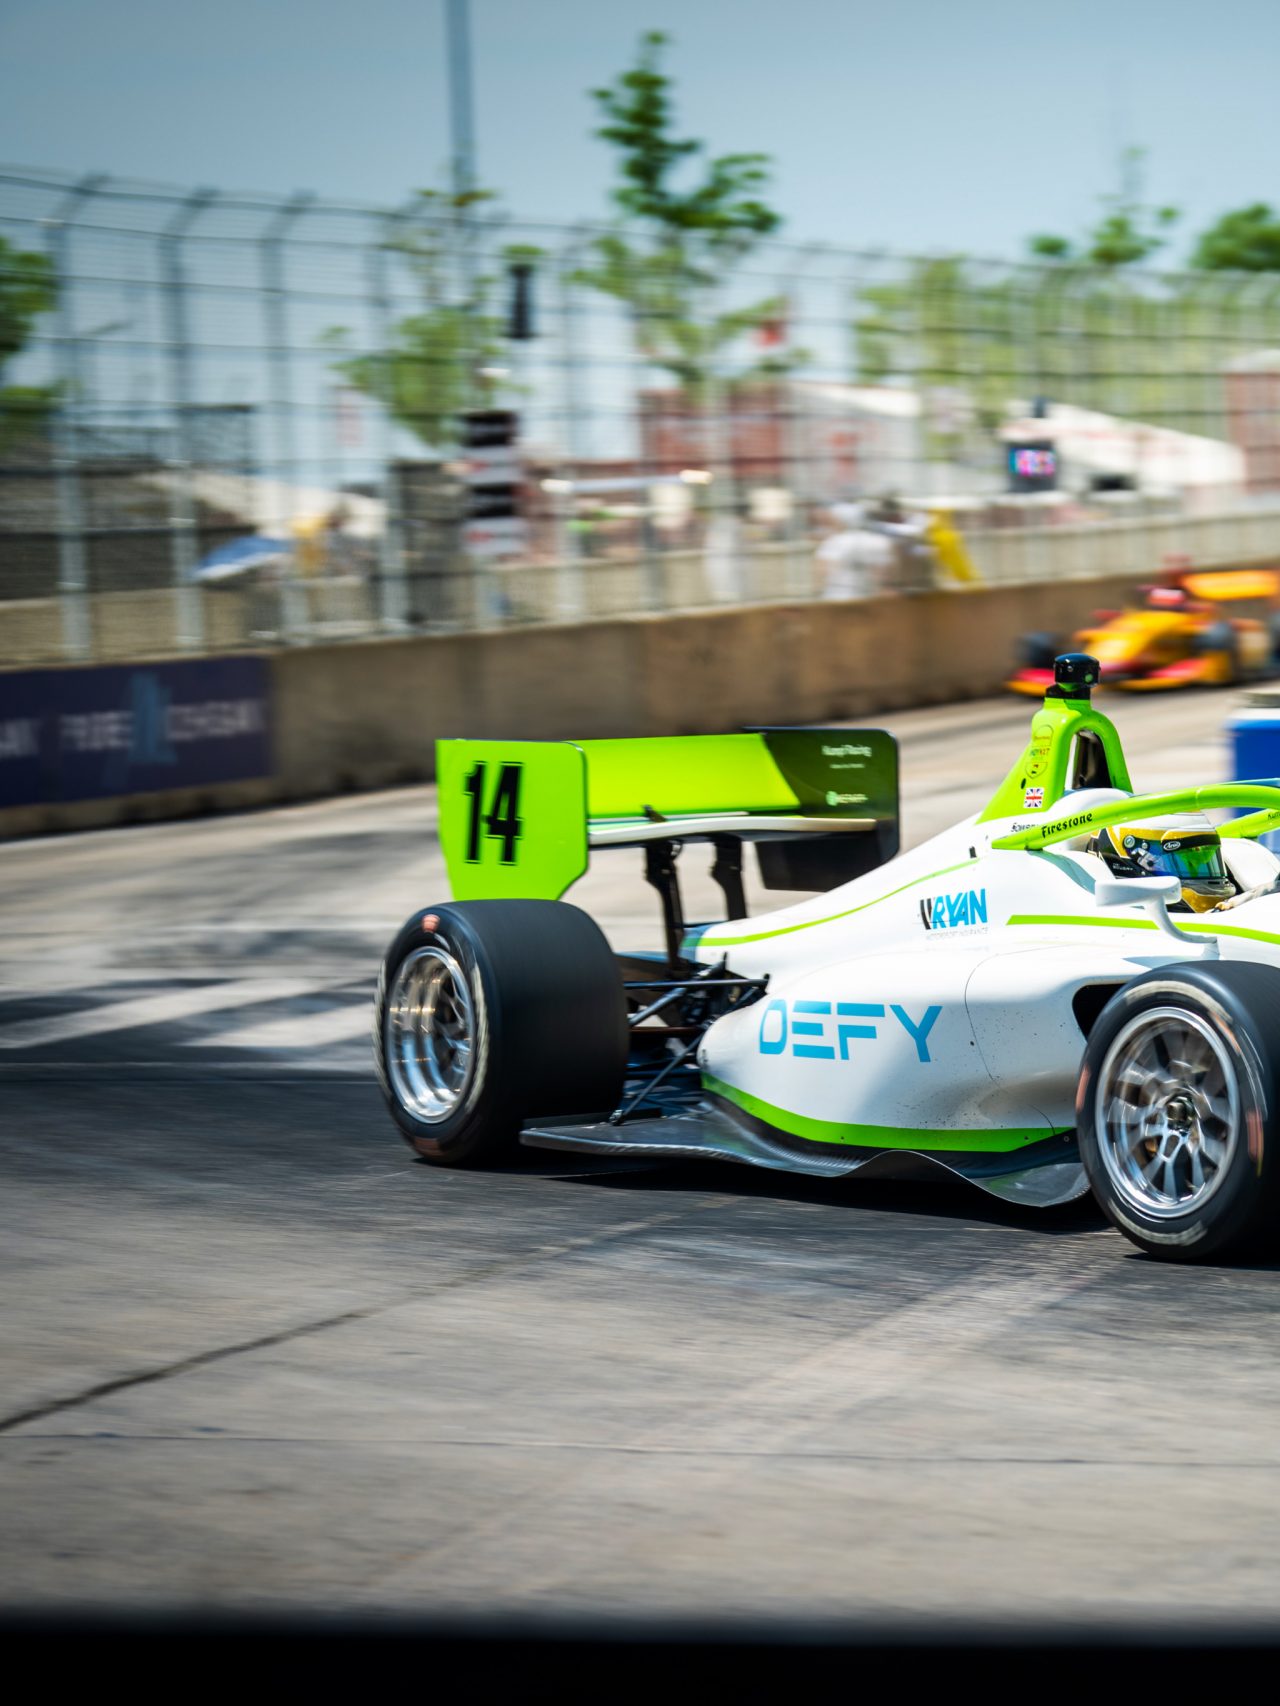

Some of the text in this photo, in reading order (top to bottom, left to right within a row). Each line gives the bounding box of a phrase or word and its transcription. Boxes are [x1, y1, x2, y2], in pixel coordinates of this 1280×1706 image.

[462, 760, 524, 866] 14
[1041, 813, 1093, 838] Firestone
[930, 888, 988, 930] RYAN
[759, 999, 943, 1063] DEFY
